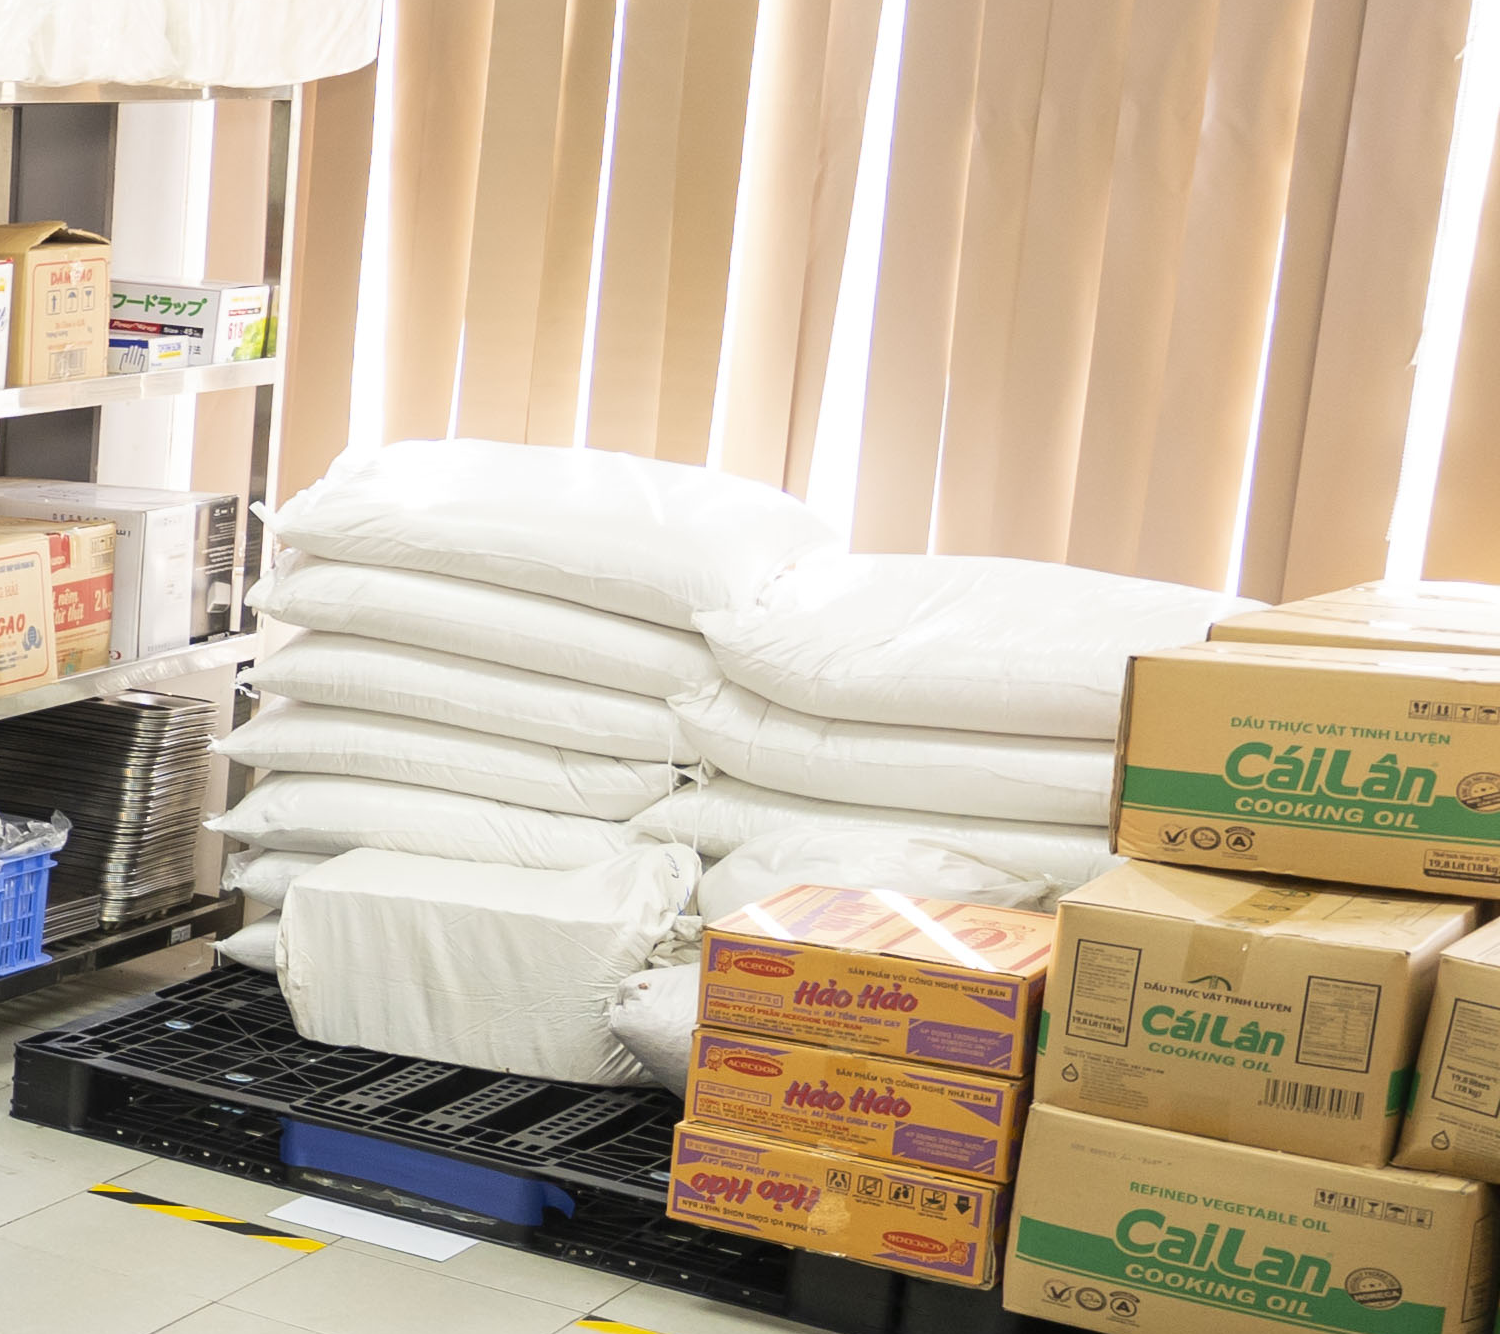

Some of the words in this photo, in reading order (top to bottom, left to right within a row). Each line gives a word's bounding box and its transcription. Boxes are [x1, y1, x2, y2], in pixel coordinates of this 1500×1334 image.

[112, 293, 208, 317] フードラップ
[1230, 716, 1266, 730] DẦU
[1268, 719, 1313, 735] THỰC
[1316, 721, 1348, 738] VẬT
[1351, 726, 1391, 740] TINH
[1394, 729, 1451, 745] LUYỆN
[1235, 796, 1365, 824] COOKING
[1373, 811, 1420, 829] OIL
[793, 979, 853, 1009] Hảo
[857, 983, 918, 1013] Hảo
[1144, 980, 1167, 993] DẦU
[1169, 984, 1200, 999] THỰC
[1202, 990, 1223, 1003] VẬT
[1224, 994, 1251, 1008] TINH
[1254, 999, 1292, 1014] LUYỆN
[1148, 1042, 1235, 1067] COOKING
[1242, 1058, 1273, 1073] OIL
[784, 1079, 844, 1111] Hảo
[849, 1085, 912, 1119] Hảo
[1129, 1181, 1199, 1205] REFINED
[1202, 1198, 1298, 1226] VEGETABLE
[1301, 1215, 1331, 1233] OIL
[1125, 1263, 1256, 1305] COOKING
[1266, 1294, 1313, 1317] OIL
